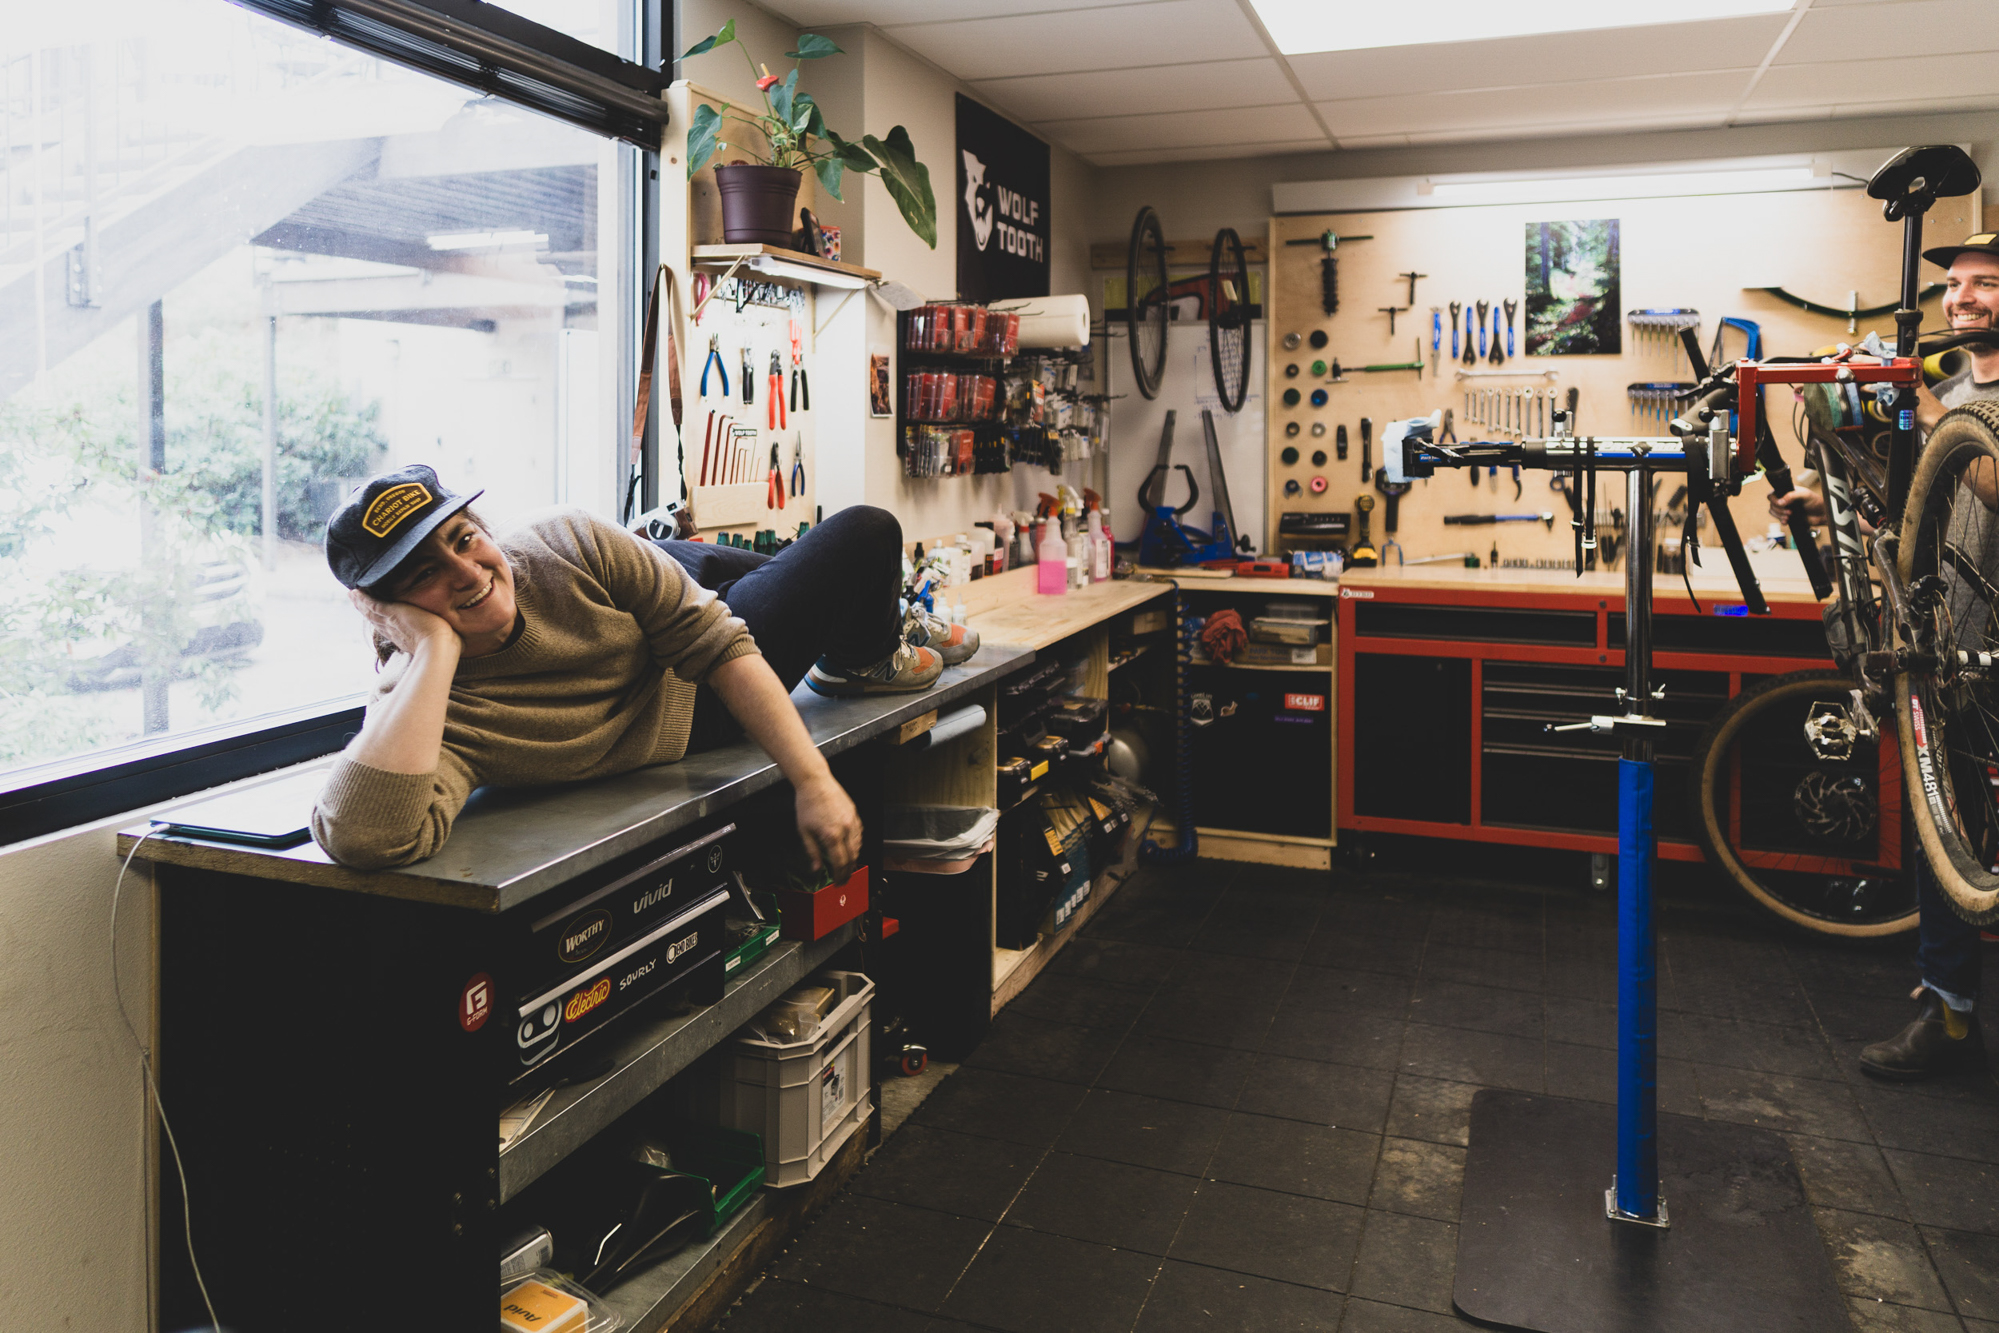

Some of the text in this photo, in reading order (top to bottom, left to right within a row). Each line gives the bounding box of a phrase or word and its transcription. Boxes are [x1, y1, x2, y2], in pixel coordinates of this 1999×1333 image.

[997, 185, 1039, 226] WOLF
[997, 221, 1043, 263] TOOTH
[372, 490, 421, 526] CHARIOT BIKE
[1296, 696, 1319, 707] CLIF
[1911, 699, 1921, 730] DT SWISS
[1917, 745, 1940, 797] XM481
[633, 878, 673, 914] vivid
[566, 919, 604, 953] WORTHY
[619, 958, 656, 991] SOURLY
[467, 1006, 488, 1026] G-FORM
[565, 979, 610, 1020] Electric
[503, 1304, 542, 1322] Avid
